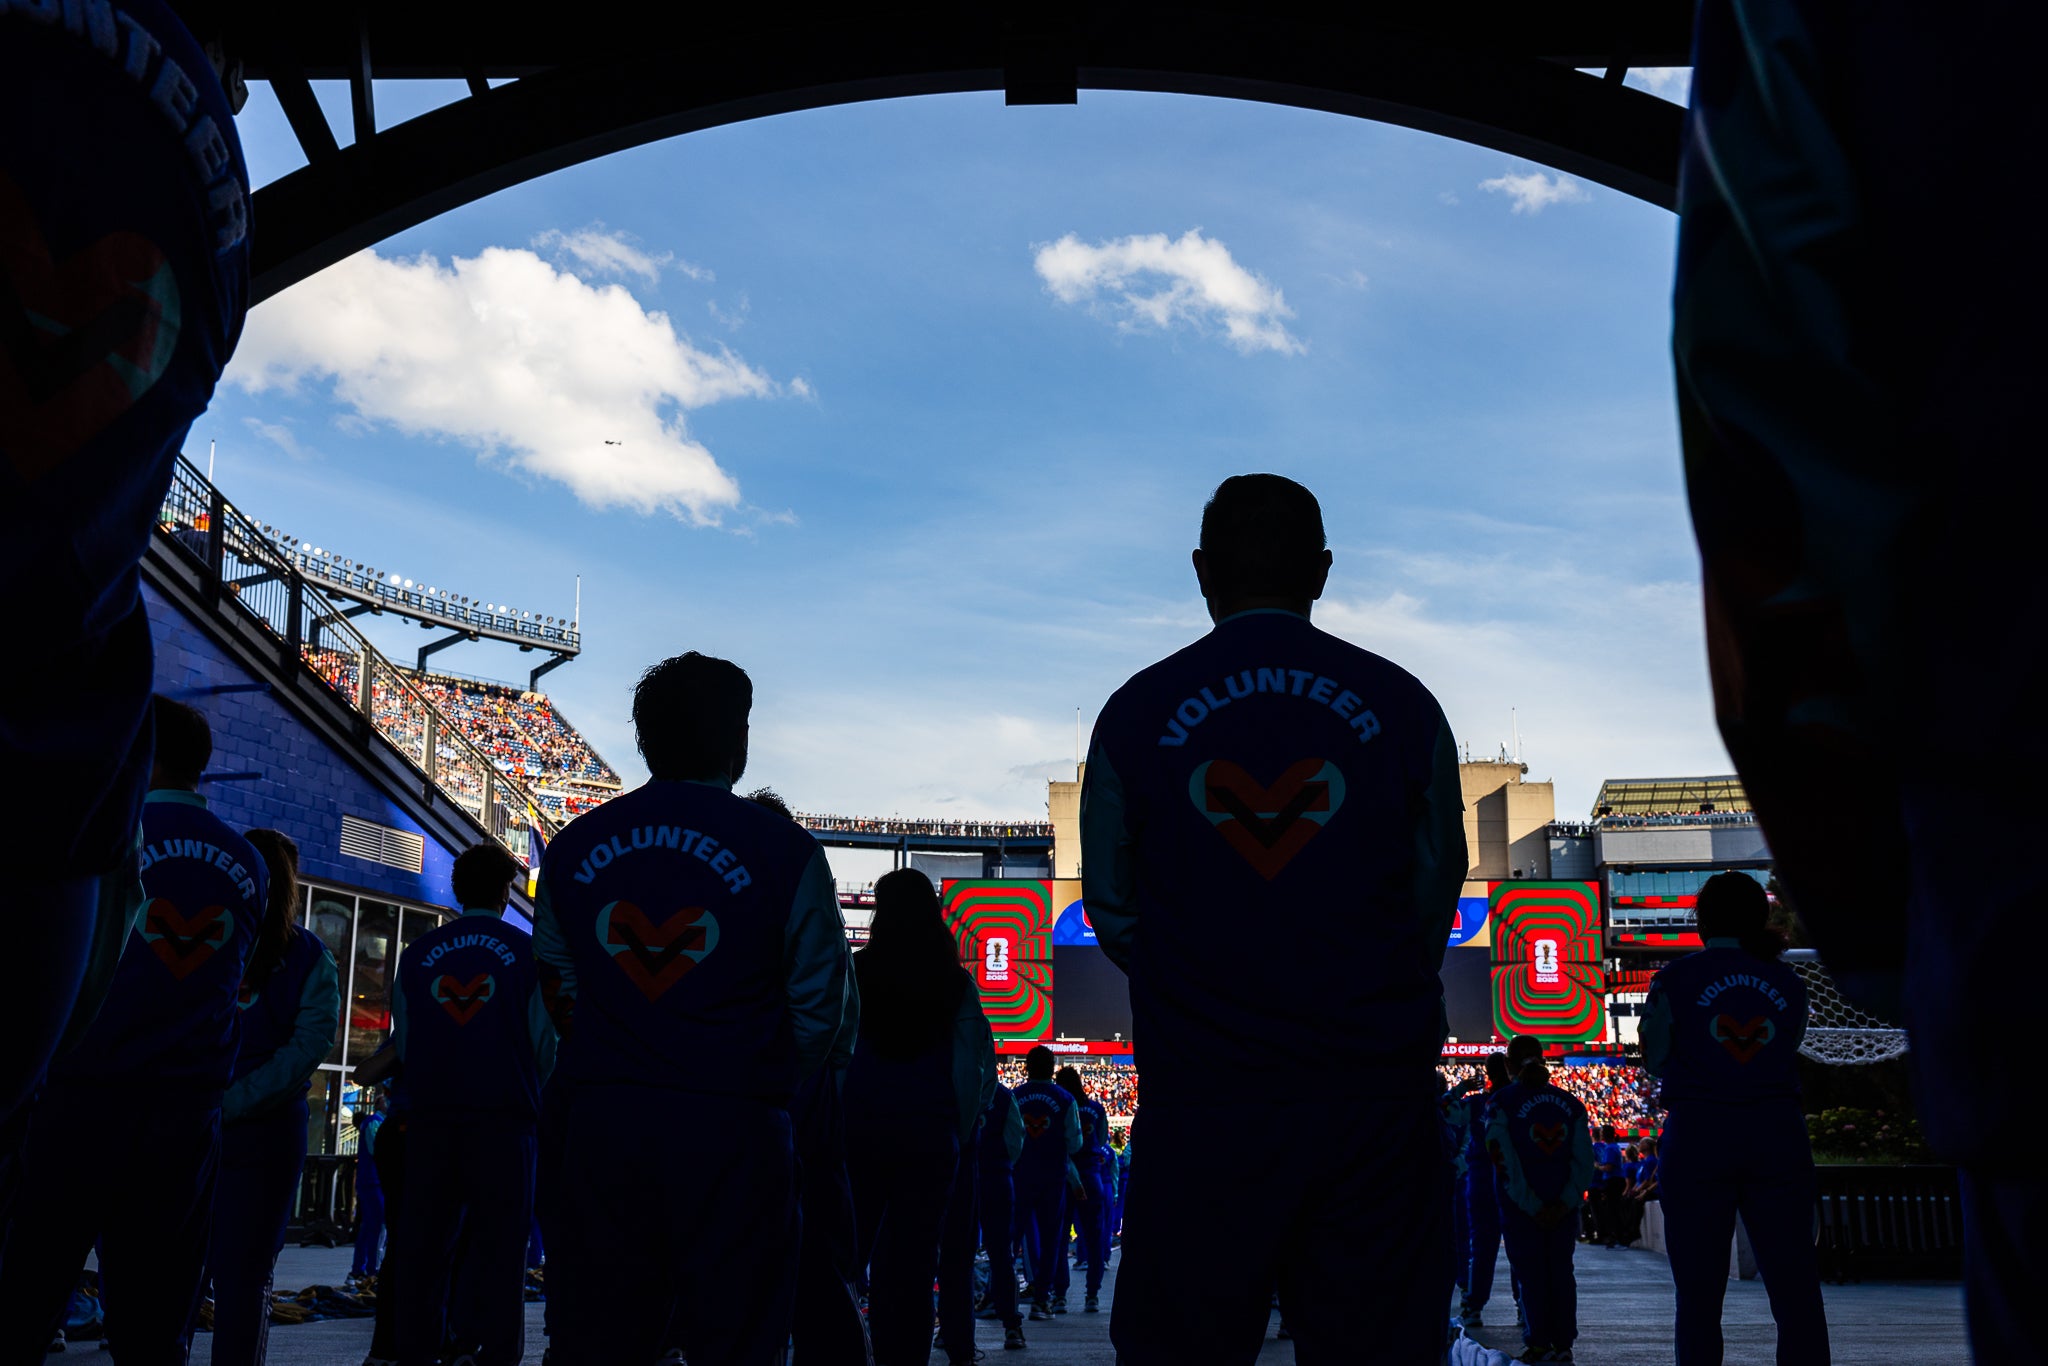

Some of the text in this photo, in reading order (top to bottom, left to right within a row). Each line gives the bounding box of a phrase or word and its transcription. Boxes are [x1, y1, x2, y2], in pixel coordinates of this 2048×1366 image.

[1157, 667, 1383, 747] VOLUNTEER
[573, 825, 753, 895] VOLUNTEER
[420, 933, 517, 968] VOLUNTEER
[1696, 973, 1788, 1012] VOLUNTEER
[1458, 1045, 1479, 1055] CUP
[1480, 1045, 1508, 1055] 202
